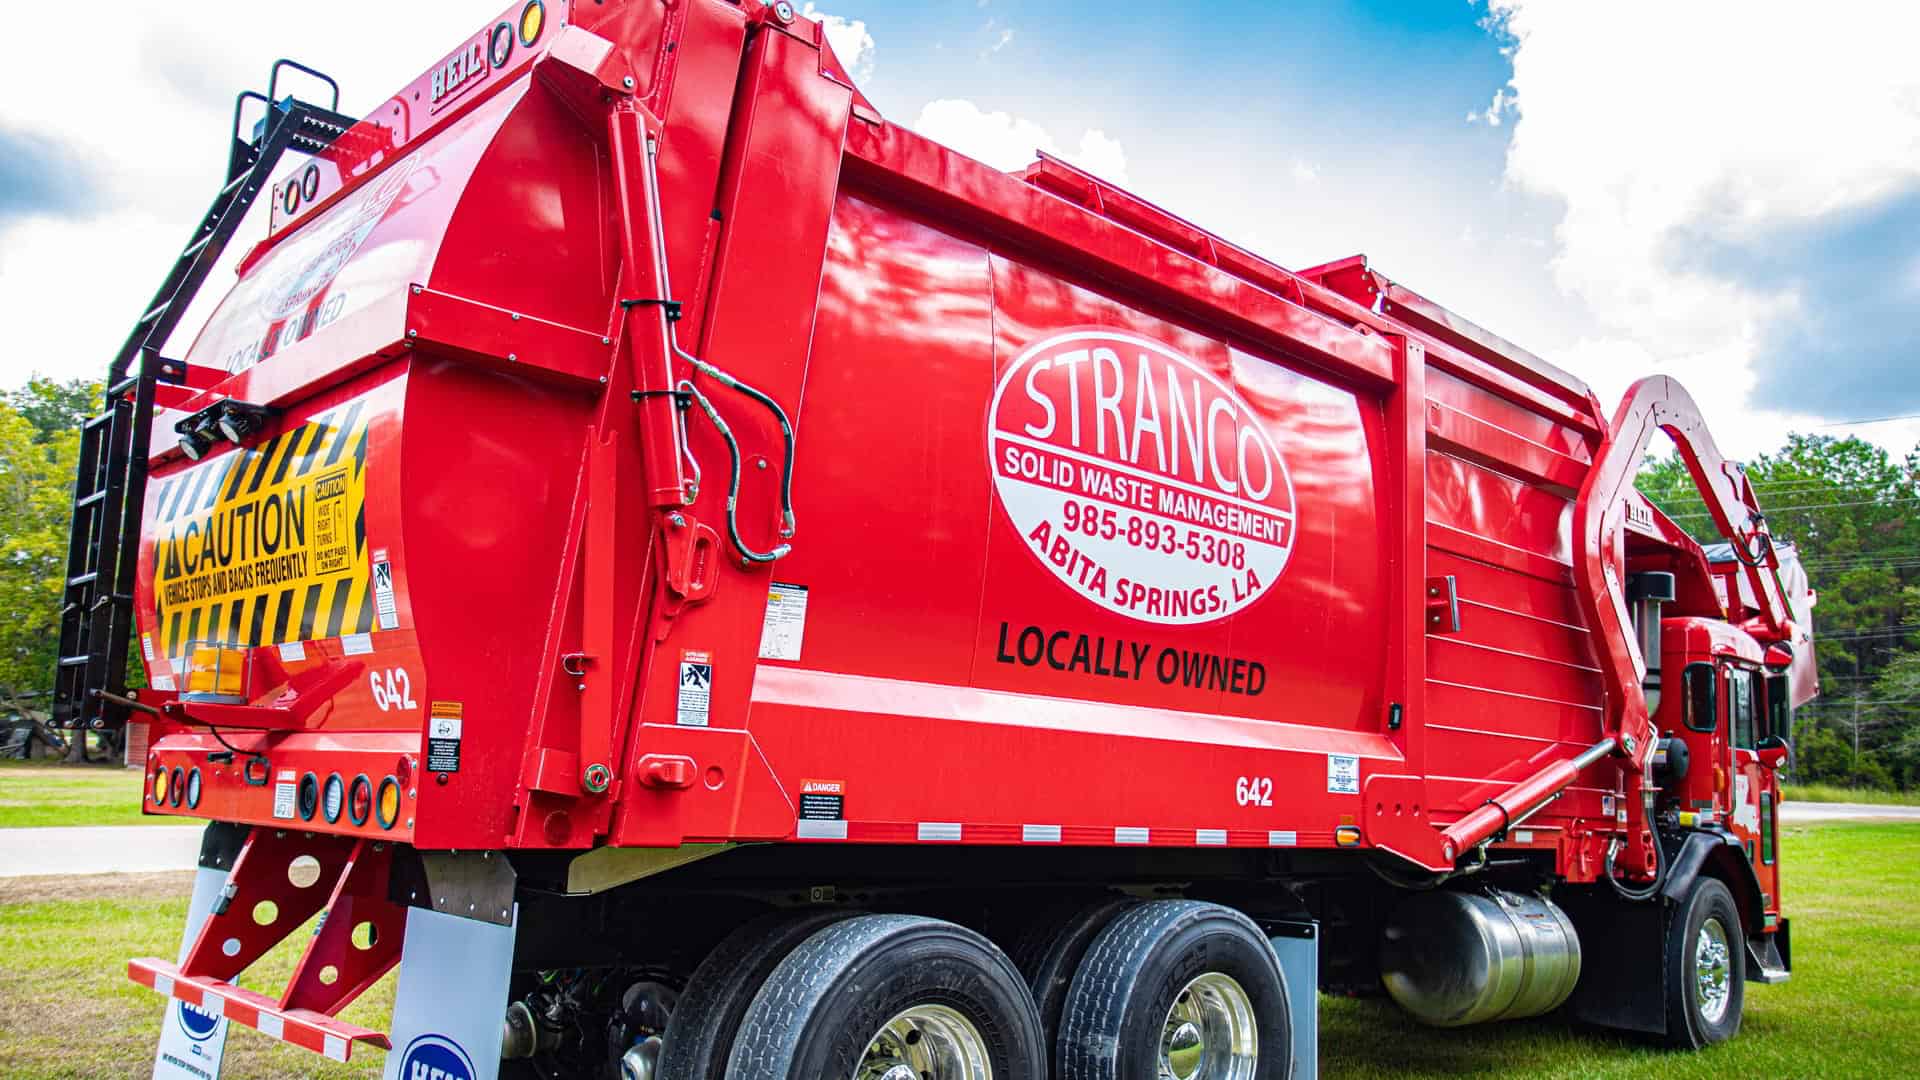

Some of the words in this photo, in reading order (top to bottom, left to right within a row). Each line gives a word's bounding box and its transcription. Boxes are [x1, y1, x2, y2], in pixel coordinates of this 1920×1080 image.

[431, 43, 482, 102] HEIL
[1024, 347, 1273, 501] STRANCO
[316, 476, 346, 498] CAUTION
[1004, 446, 1075, 488] SOLID
[1080, 468, 1154, 509] WASTE
[1158, 493, 1286, 544] MANAGEMENT
[183, 484, 307, 576] CAUTION
[1063, 499, 1246, 571] 985-893-5308
[164, 577, 190, 607] VEHICLE
[190, 573, 212, 601] STOPS
[213, 570, 227, 597] AND
[228, 564, 254, 593] BACKS
[255, 550, 308, 588] FREQUENTLY
[1029, 519, 1108, 599] ABITA
[1113, 577, 1228, 618] SPRINGS,
[1231, 567, 1262, 604] LA
[369, 667, 417, 712] 642
[996, 621, 1151, 681] LOCALLY
[1156, 647, 1266, 697] OWNED
[812, 782, 841, 793] DANGER
[1235, 776, 1274, 807] 642
